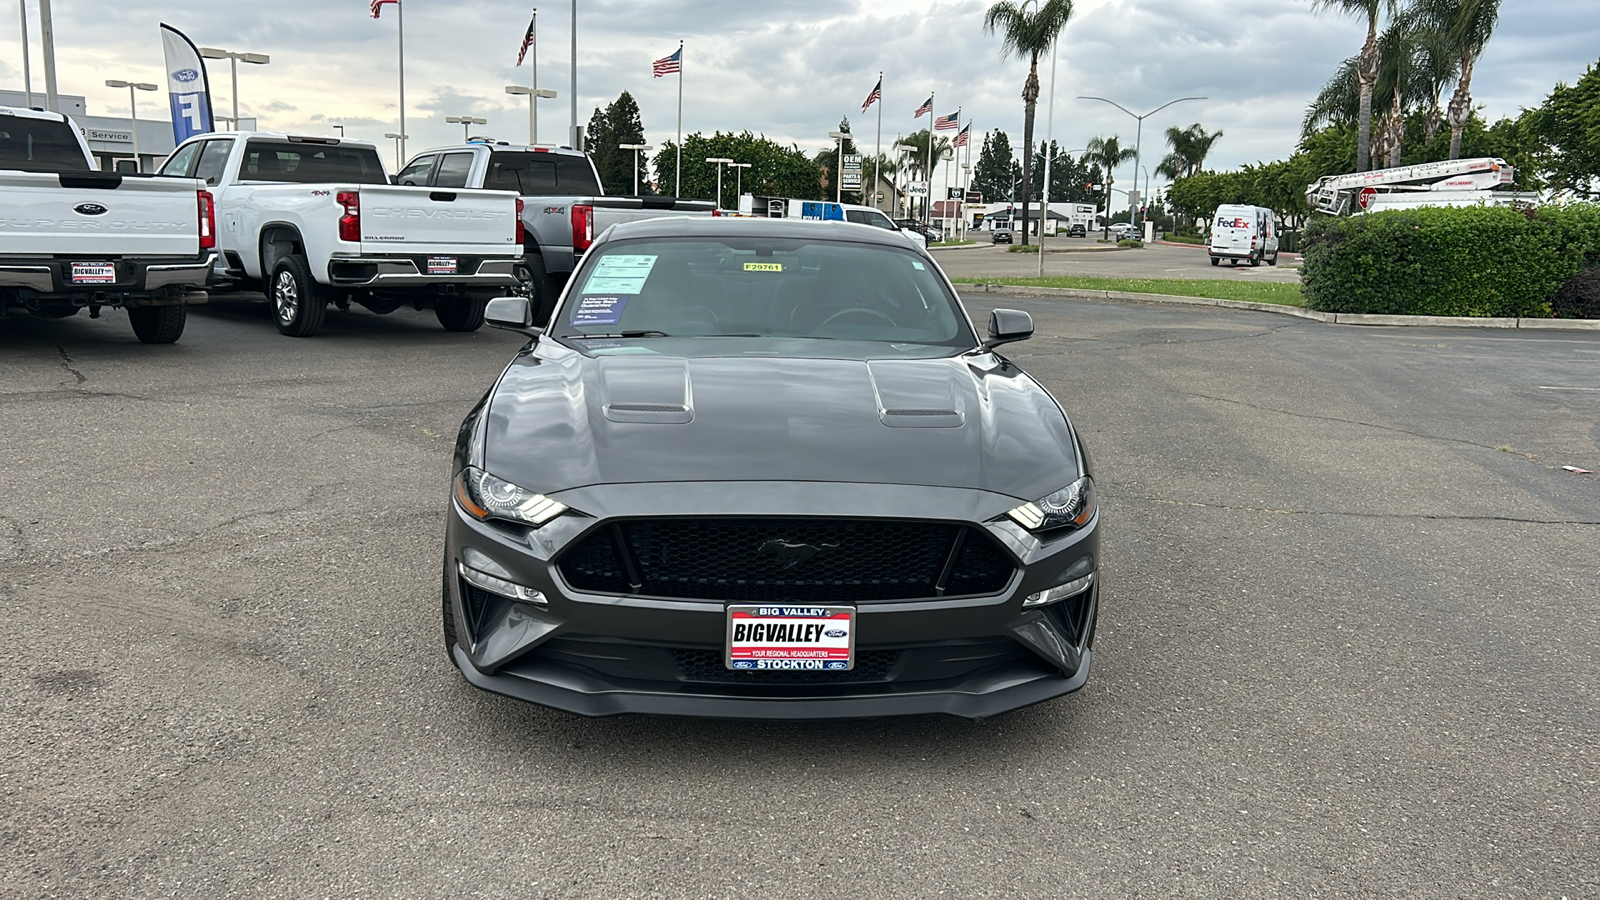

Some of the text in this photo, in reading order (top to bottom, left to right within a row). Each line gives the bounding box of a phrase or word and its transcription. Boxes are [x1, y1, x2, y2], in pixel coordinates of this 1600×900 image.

[92, 131, 129, 140] Service
[909, 186, 927, 194] Jeep
[372, 207, 507, 221] CHEVROLET
[109, 220, 188, 230] DUTY
[1217, 217, 1250, 229] FedEx
[759, 607, 825, 616] BIG VALLEY
[733, 623, 826, 643] BIGVALLEY
[826, 629, 846, 638] Ford
[769, 650, 790, 658] REGIONAL
[757, 660, 824, 669] STOCKTON
